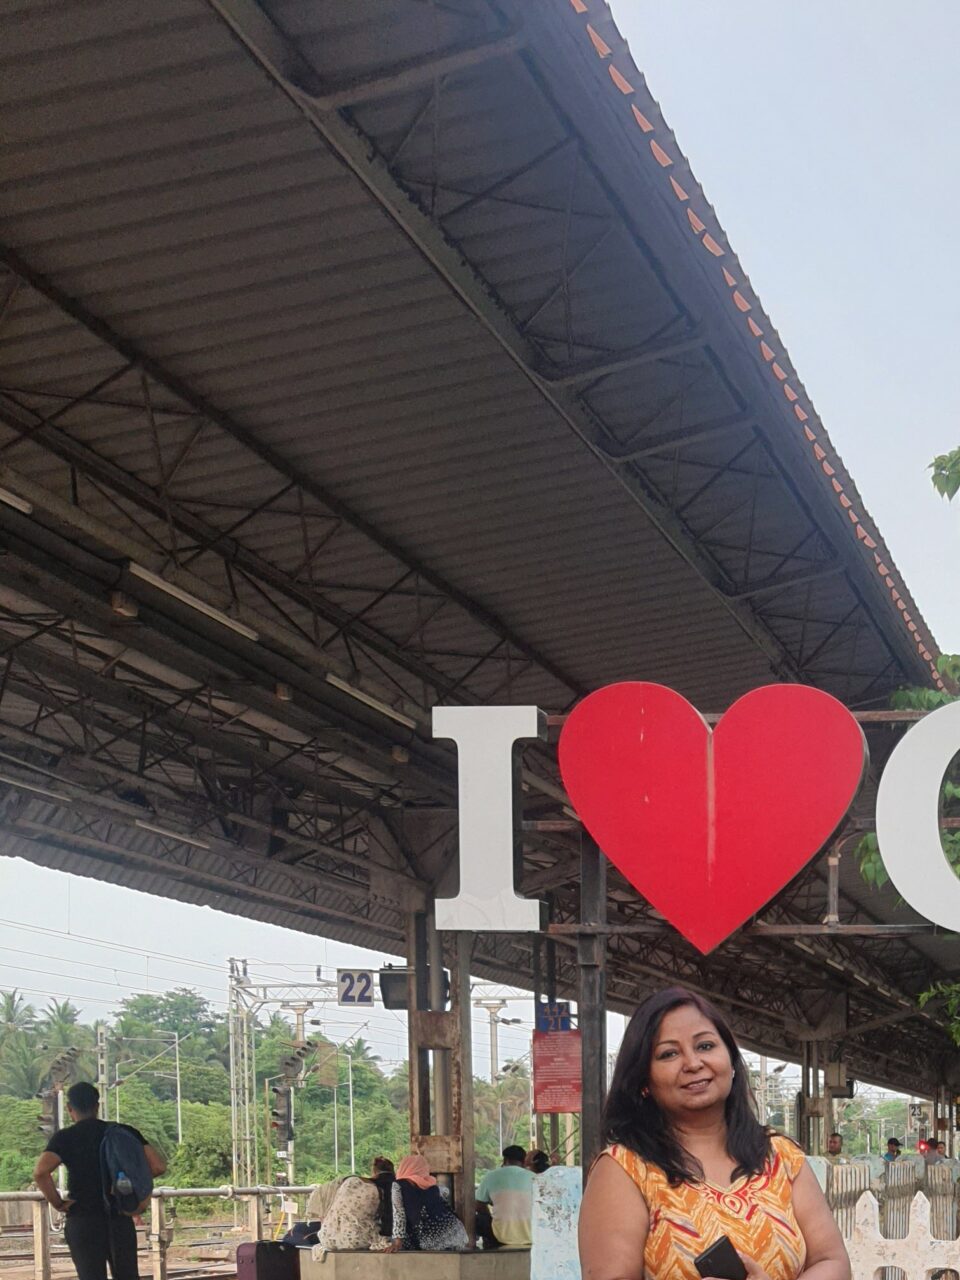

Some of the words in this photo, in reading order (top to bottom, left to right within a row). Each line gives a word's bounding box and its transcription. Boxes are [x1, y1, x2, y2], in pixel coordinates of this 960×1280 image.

[432, 705, 541, 932] I
[341, 972, 372, 1002] 22
[911, 1105, 922, 1116] 23
